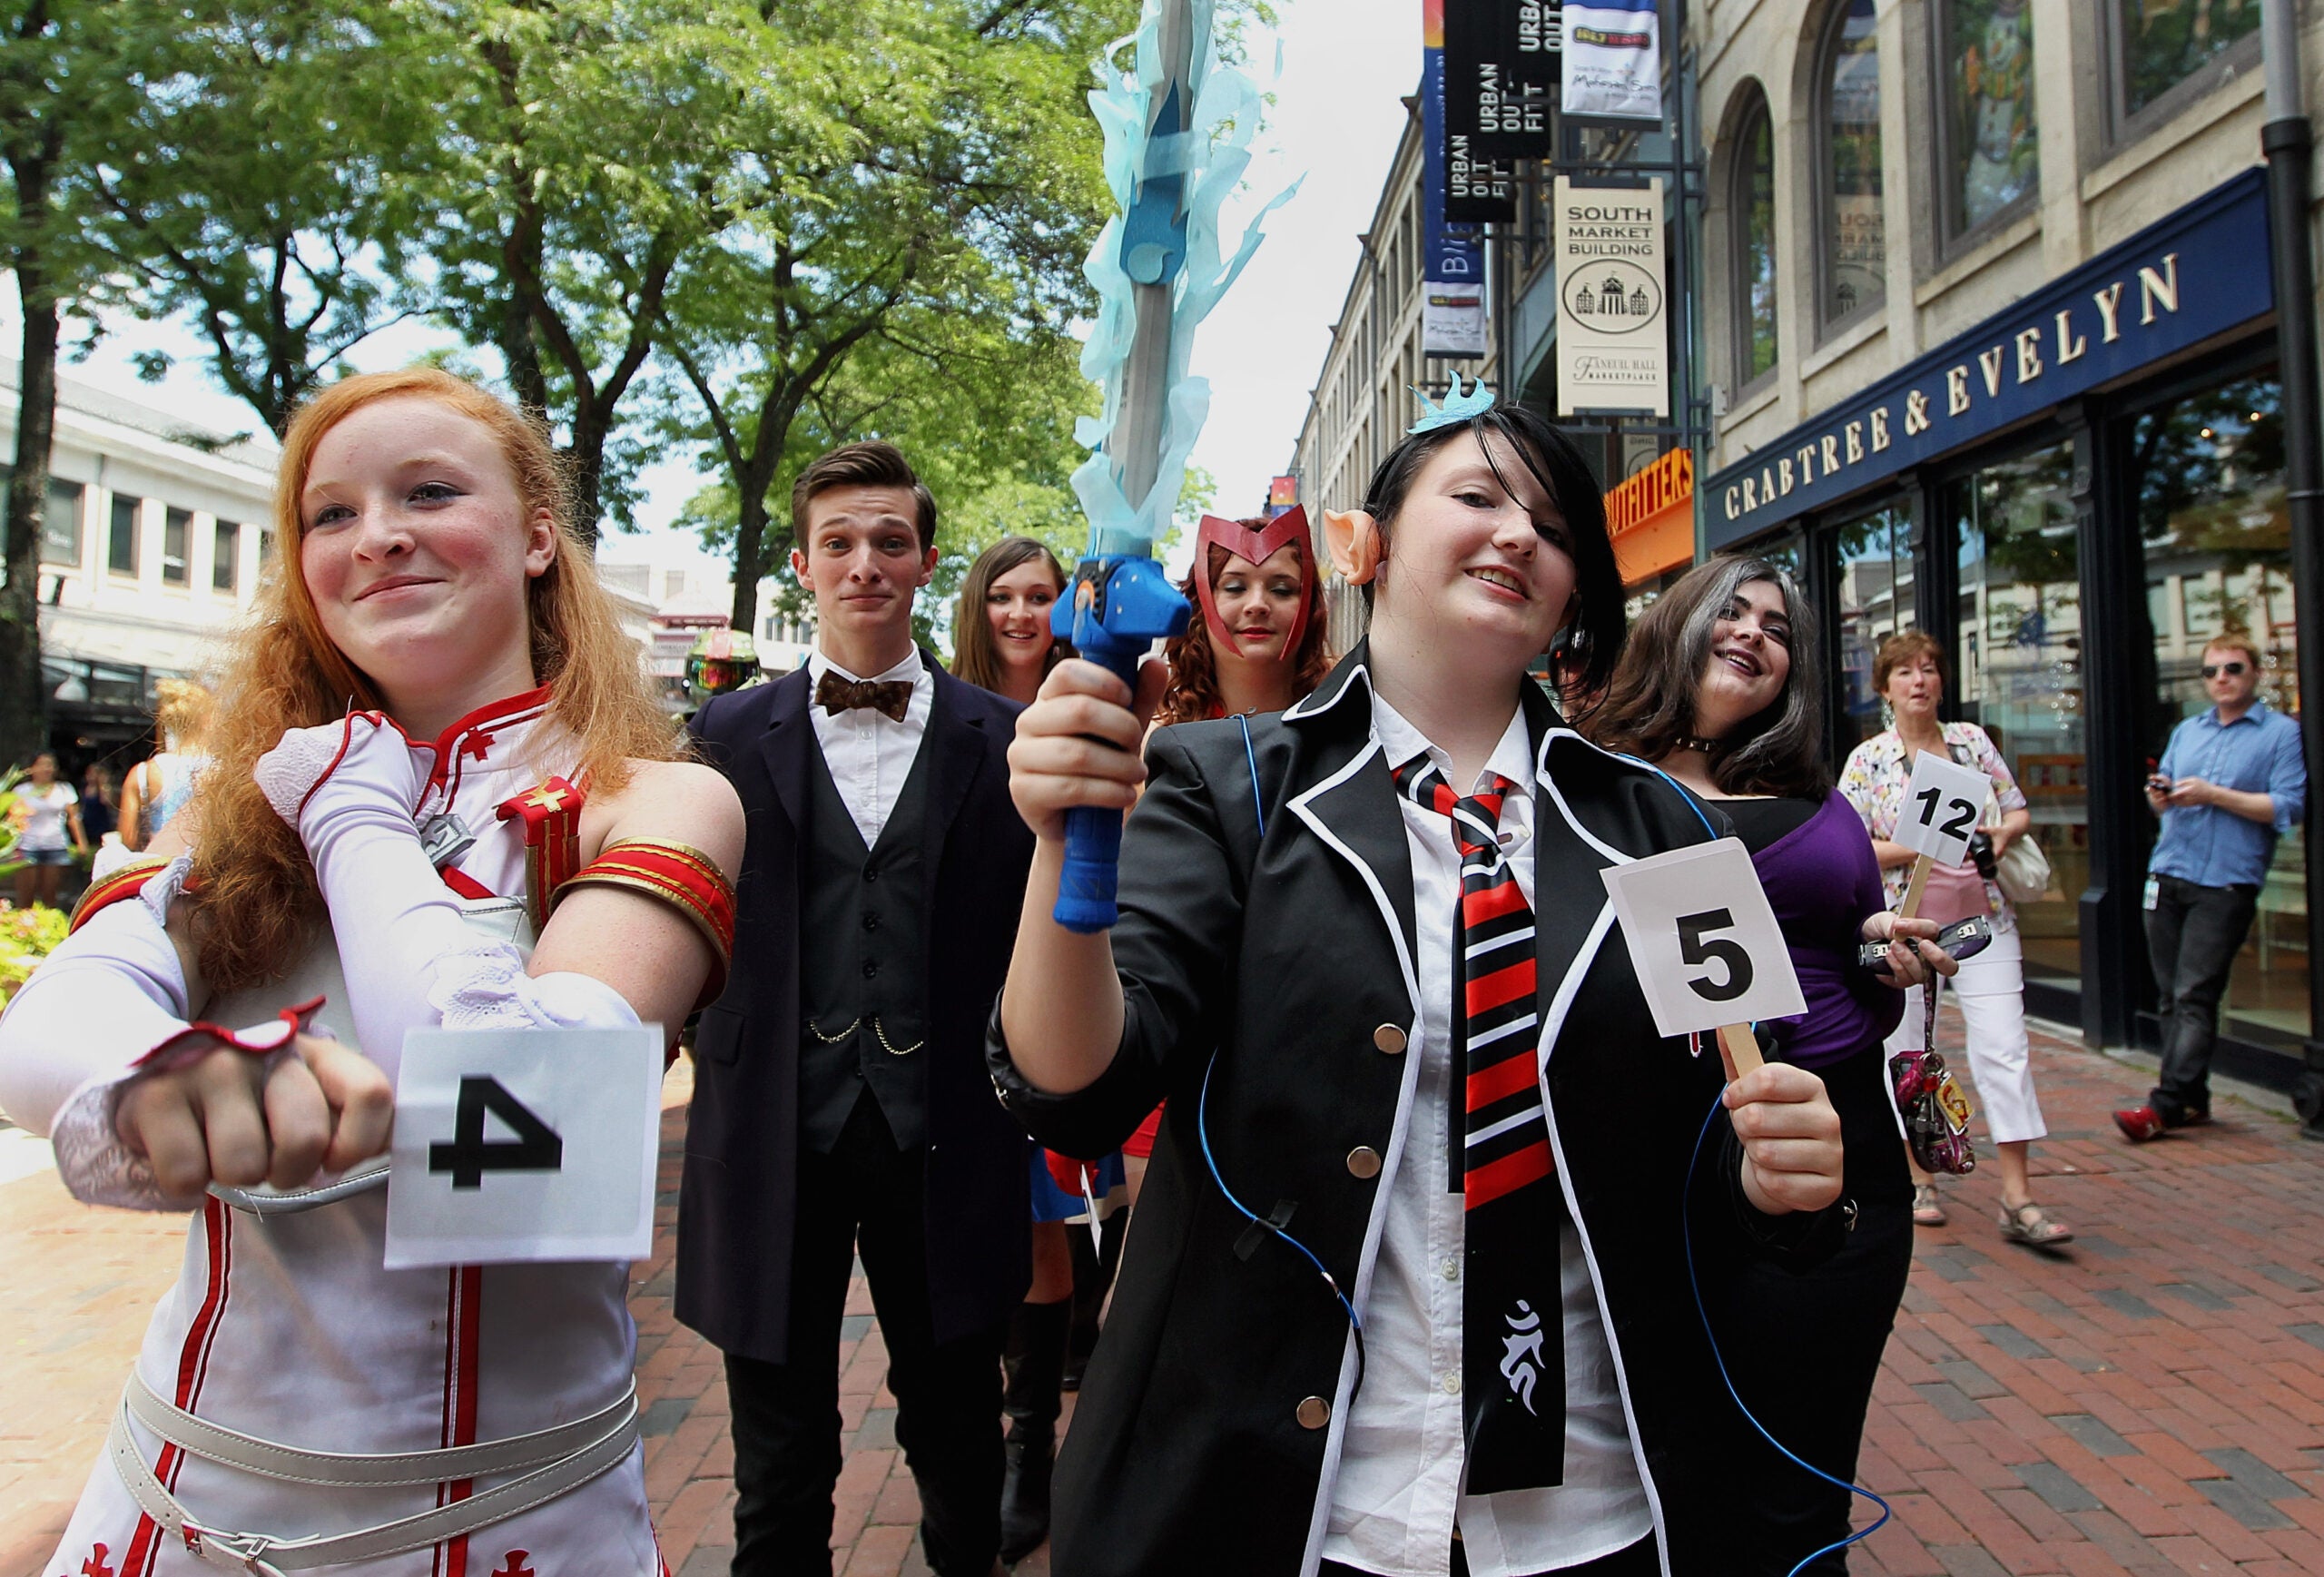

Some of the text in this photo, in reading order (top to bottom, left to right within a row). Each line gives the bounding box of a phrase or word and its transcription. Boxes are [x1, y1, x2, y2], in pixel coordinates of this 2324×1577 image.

[1478, 63, 1499, 133] URBAN
[1450, 134, 1469, 198] URBAN
[1568, 206, 1652, 222] SOUTH
[1568, 226, 1653, 238] MARKET
[1568, 243, 1653, 255] BUILDING
[1724, 252, 2179, 521] CRABTREE & EVELYN
[1915, 786, 1977, 843] 12
[1675, 907, 1754, 1002] 5
[428, 1074, 563, 1191] 4
